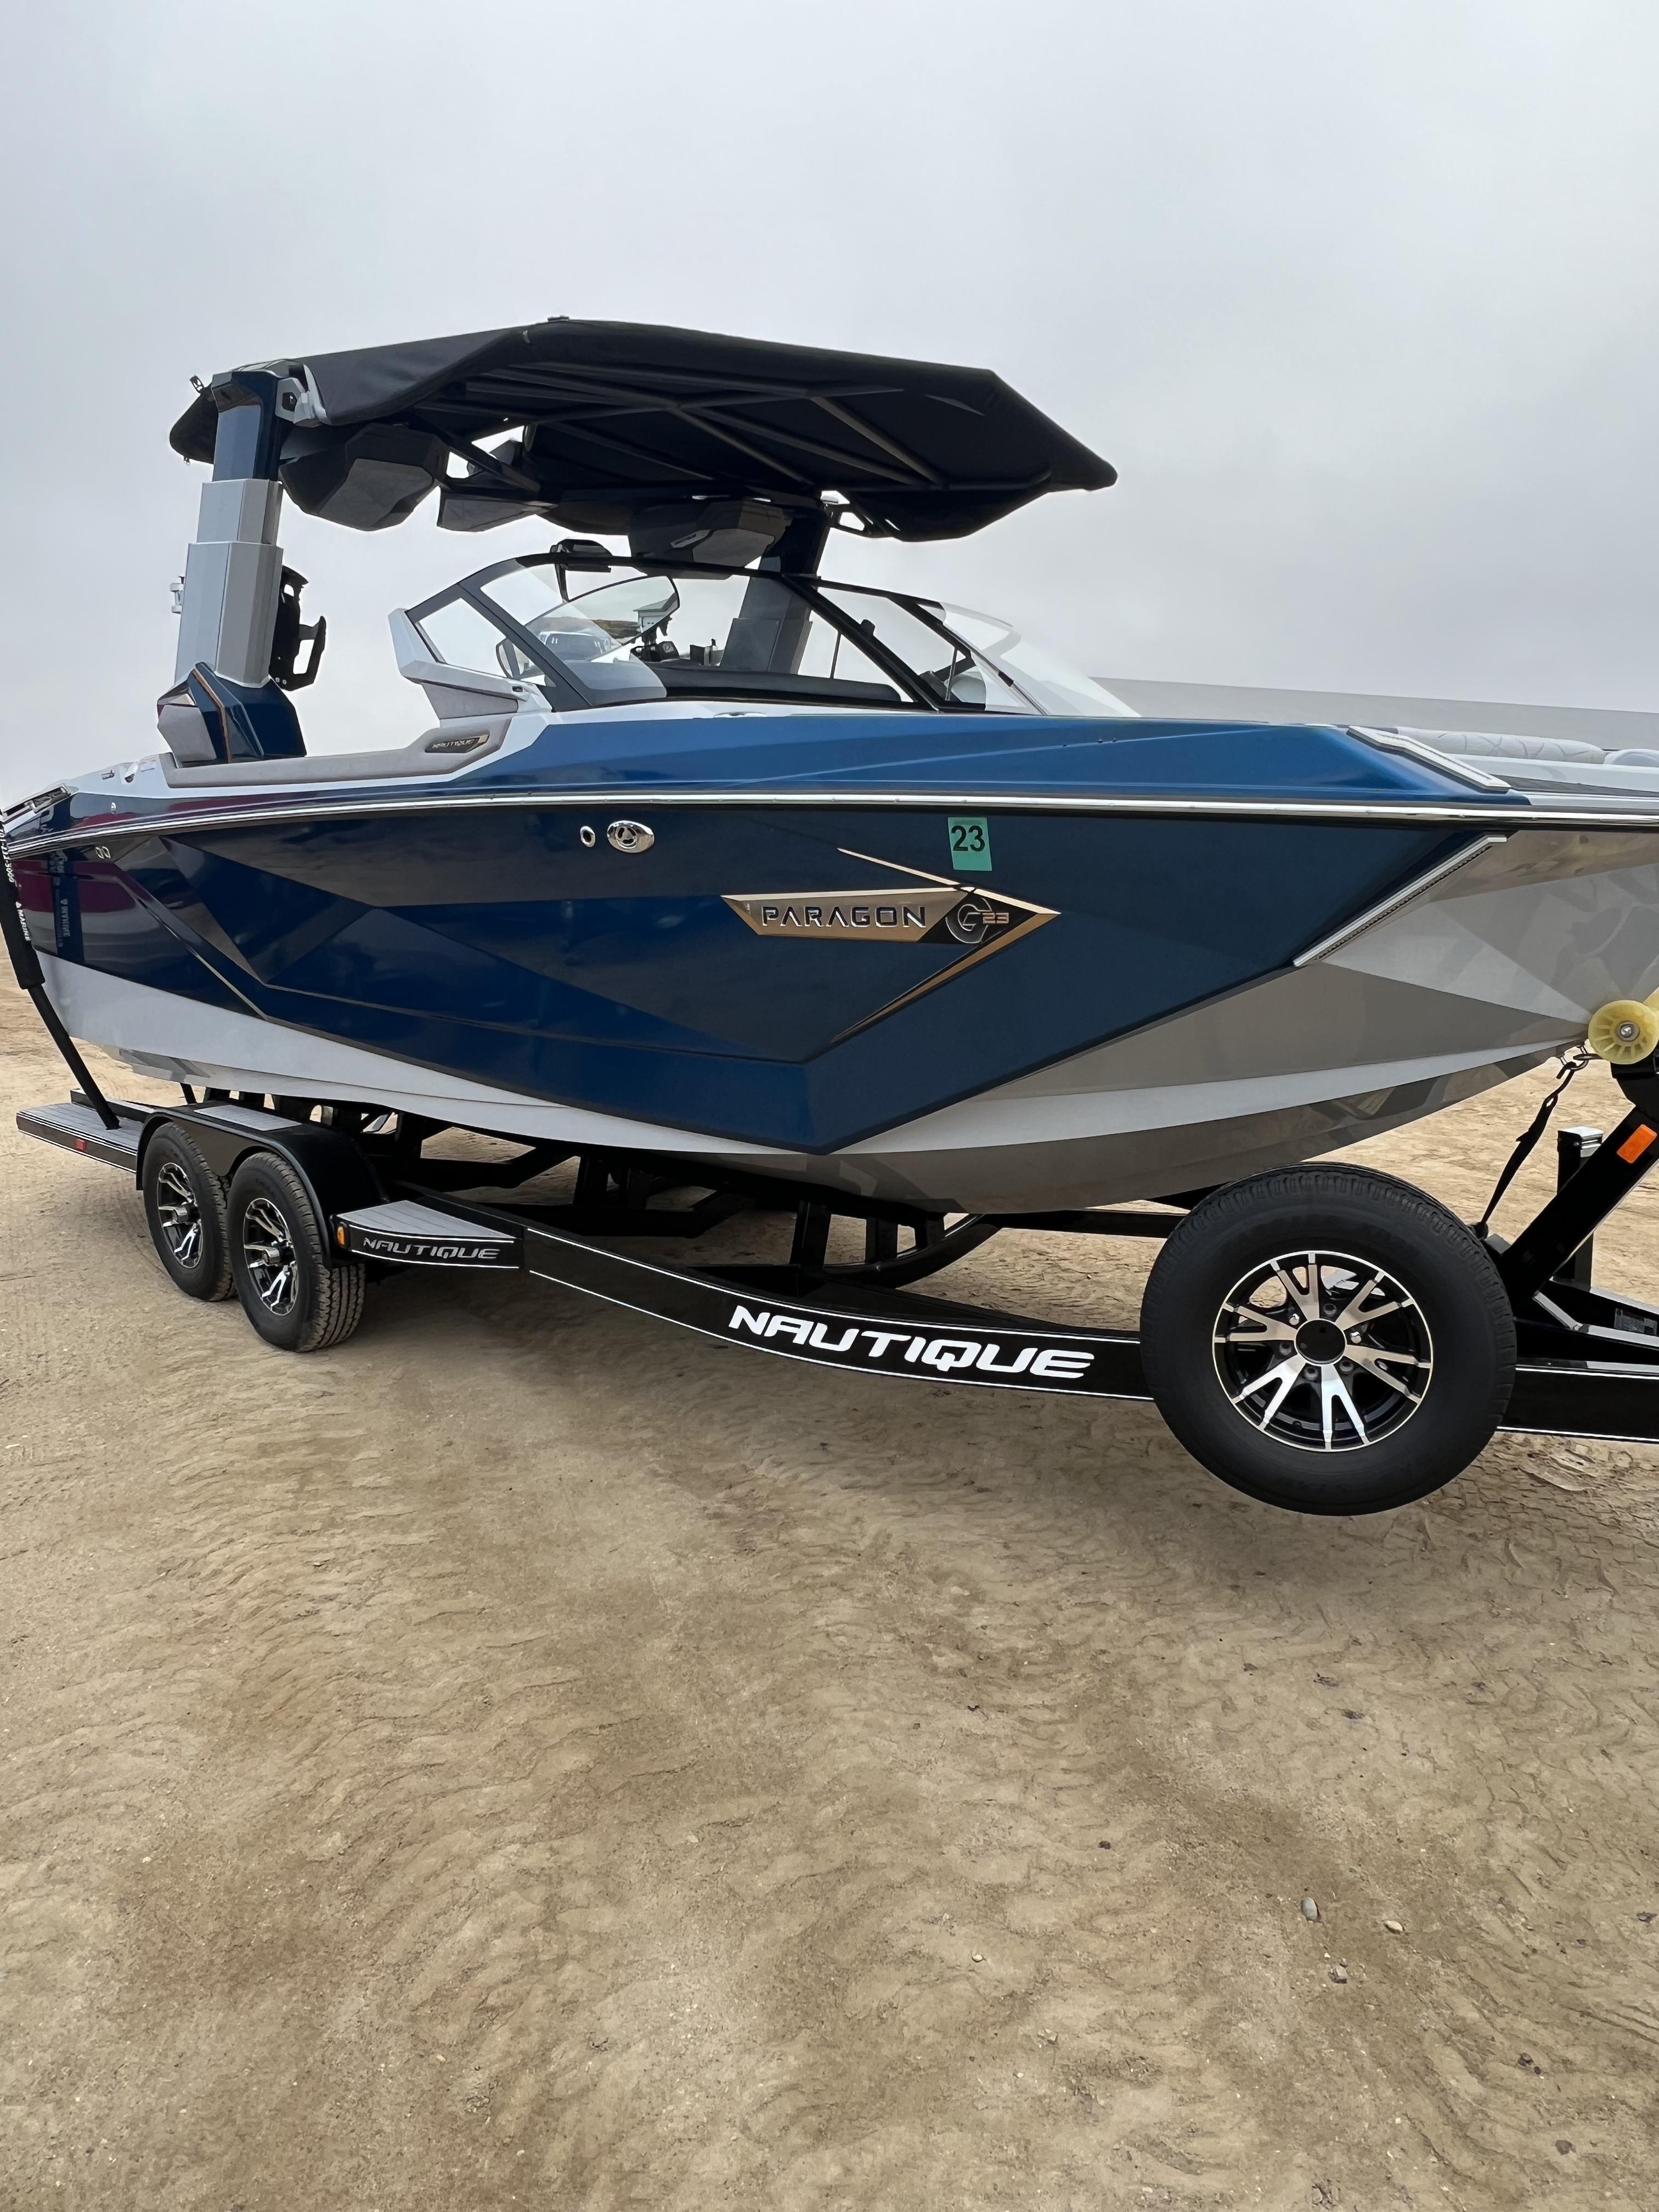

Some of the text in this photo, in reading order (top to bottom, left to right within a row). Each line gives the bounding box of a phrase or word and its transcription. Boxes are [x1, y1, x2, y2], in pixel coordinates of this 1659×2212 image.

[951, 825, 985, 852] 23
[761, 905, 926, 928] PARAGON
[363, 1237, 500, 1259] NAUTIQUE
[728, 1305, 1095, 1379] NAUTIQUE
